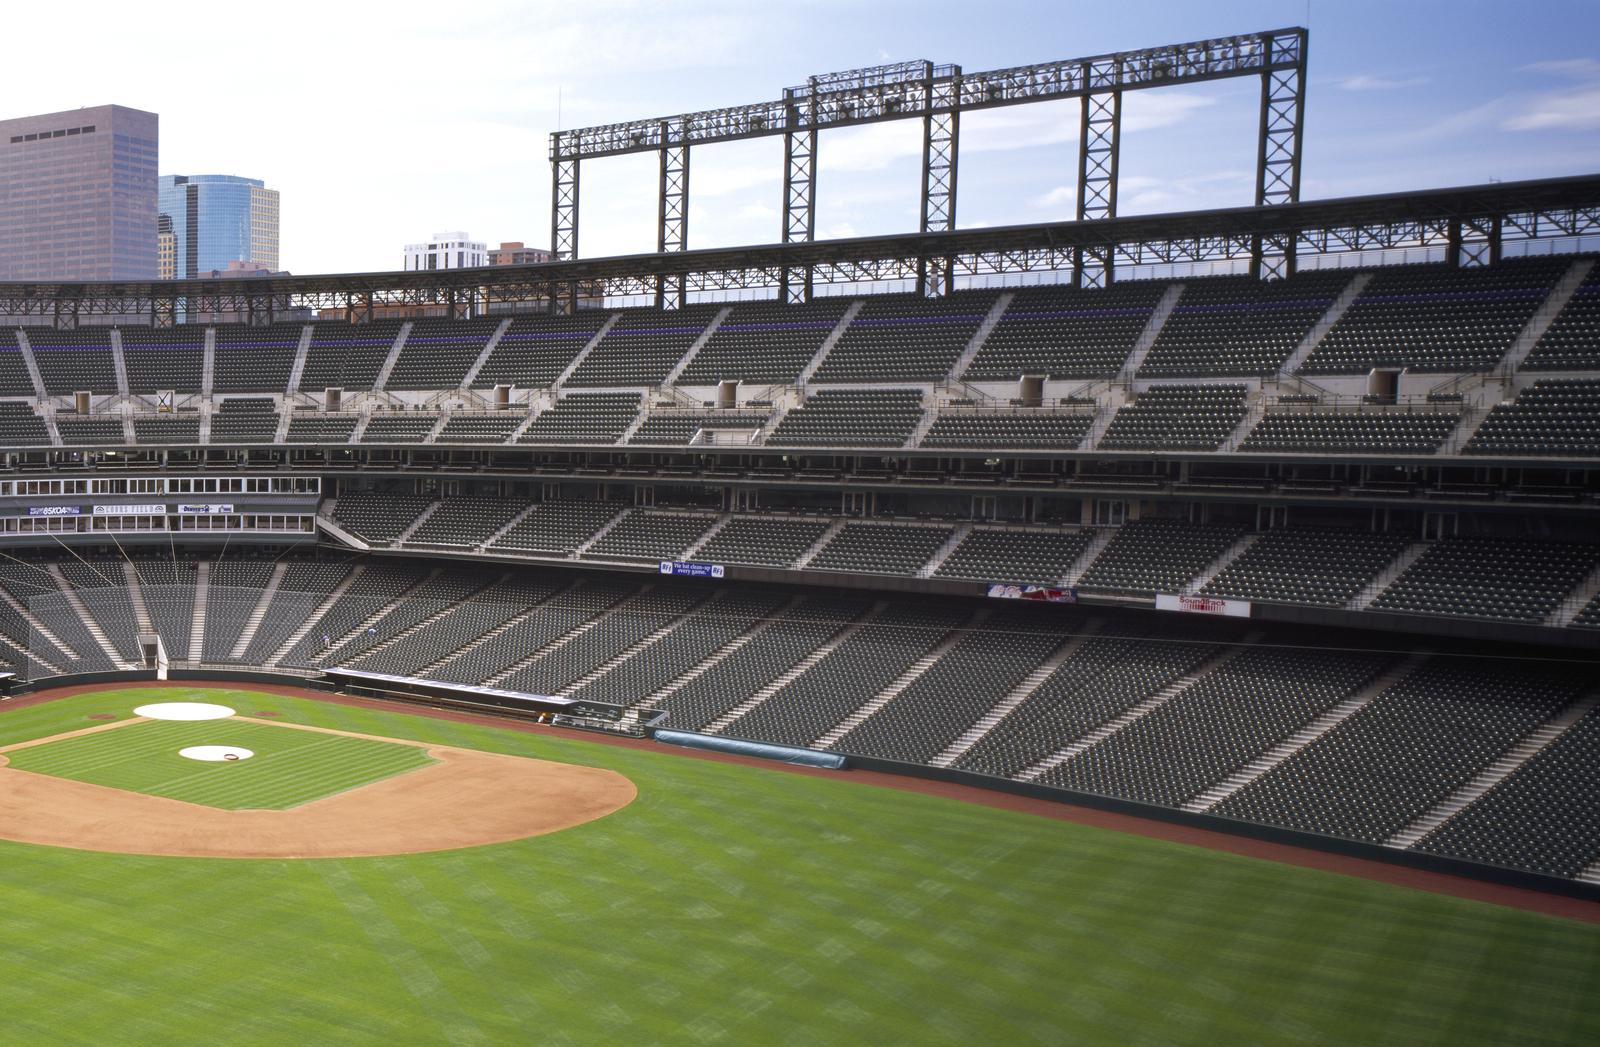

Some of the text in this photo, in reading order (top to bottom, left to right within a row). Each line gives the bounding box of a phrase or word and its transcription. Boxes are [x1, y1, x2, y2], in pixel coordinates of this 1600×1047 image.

[106, 505, 128, 513] COORS
[662, 563, 672, 572] BFI
[690, 564, 710, 572] clean-up
[713, 567, 723, 576] BFI
